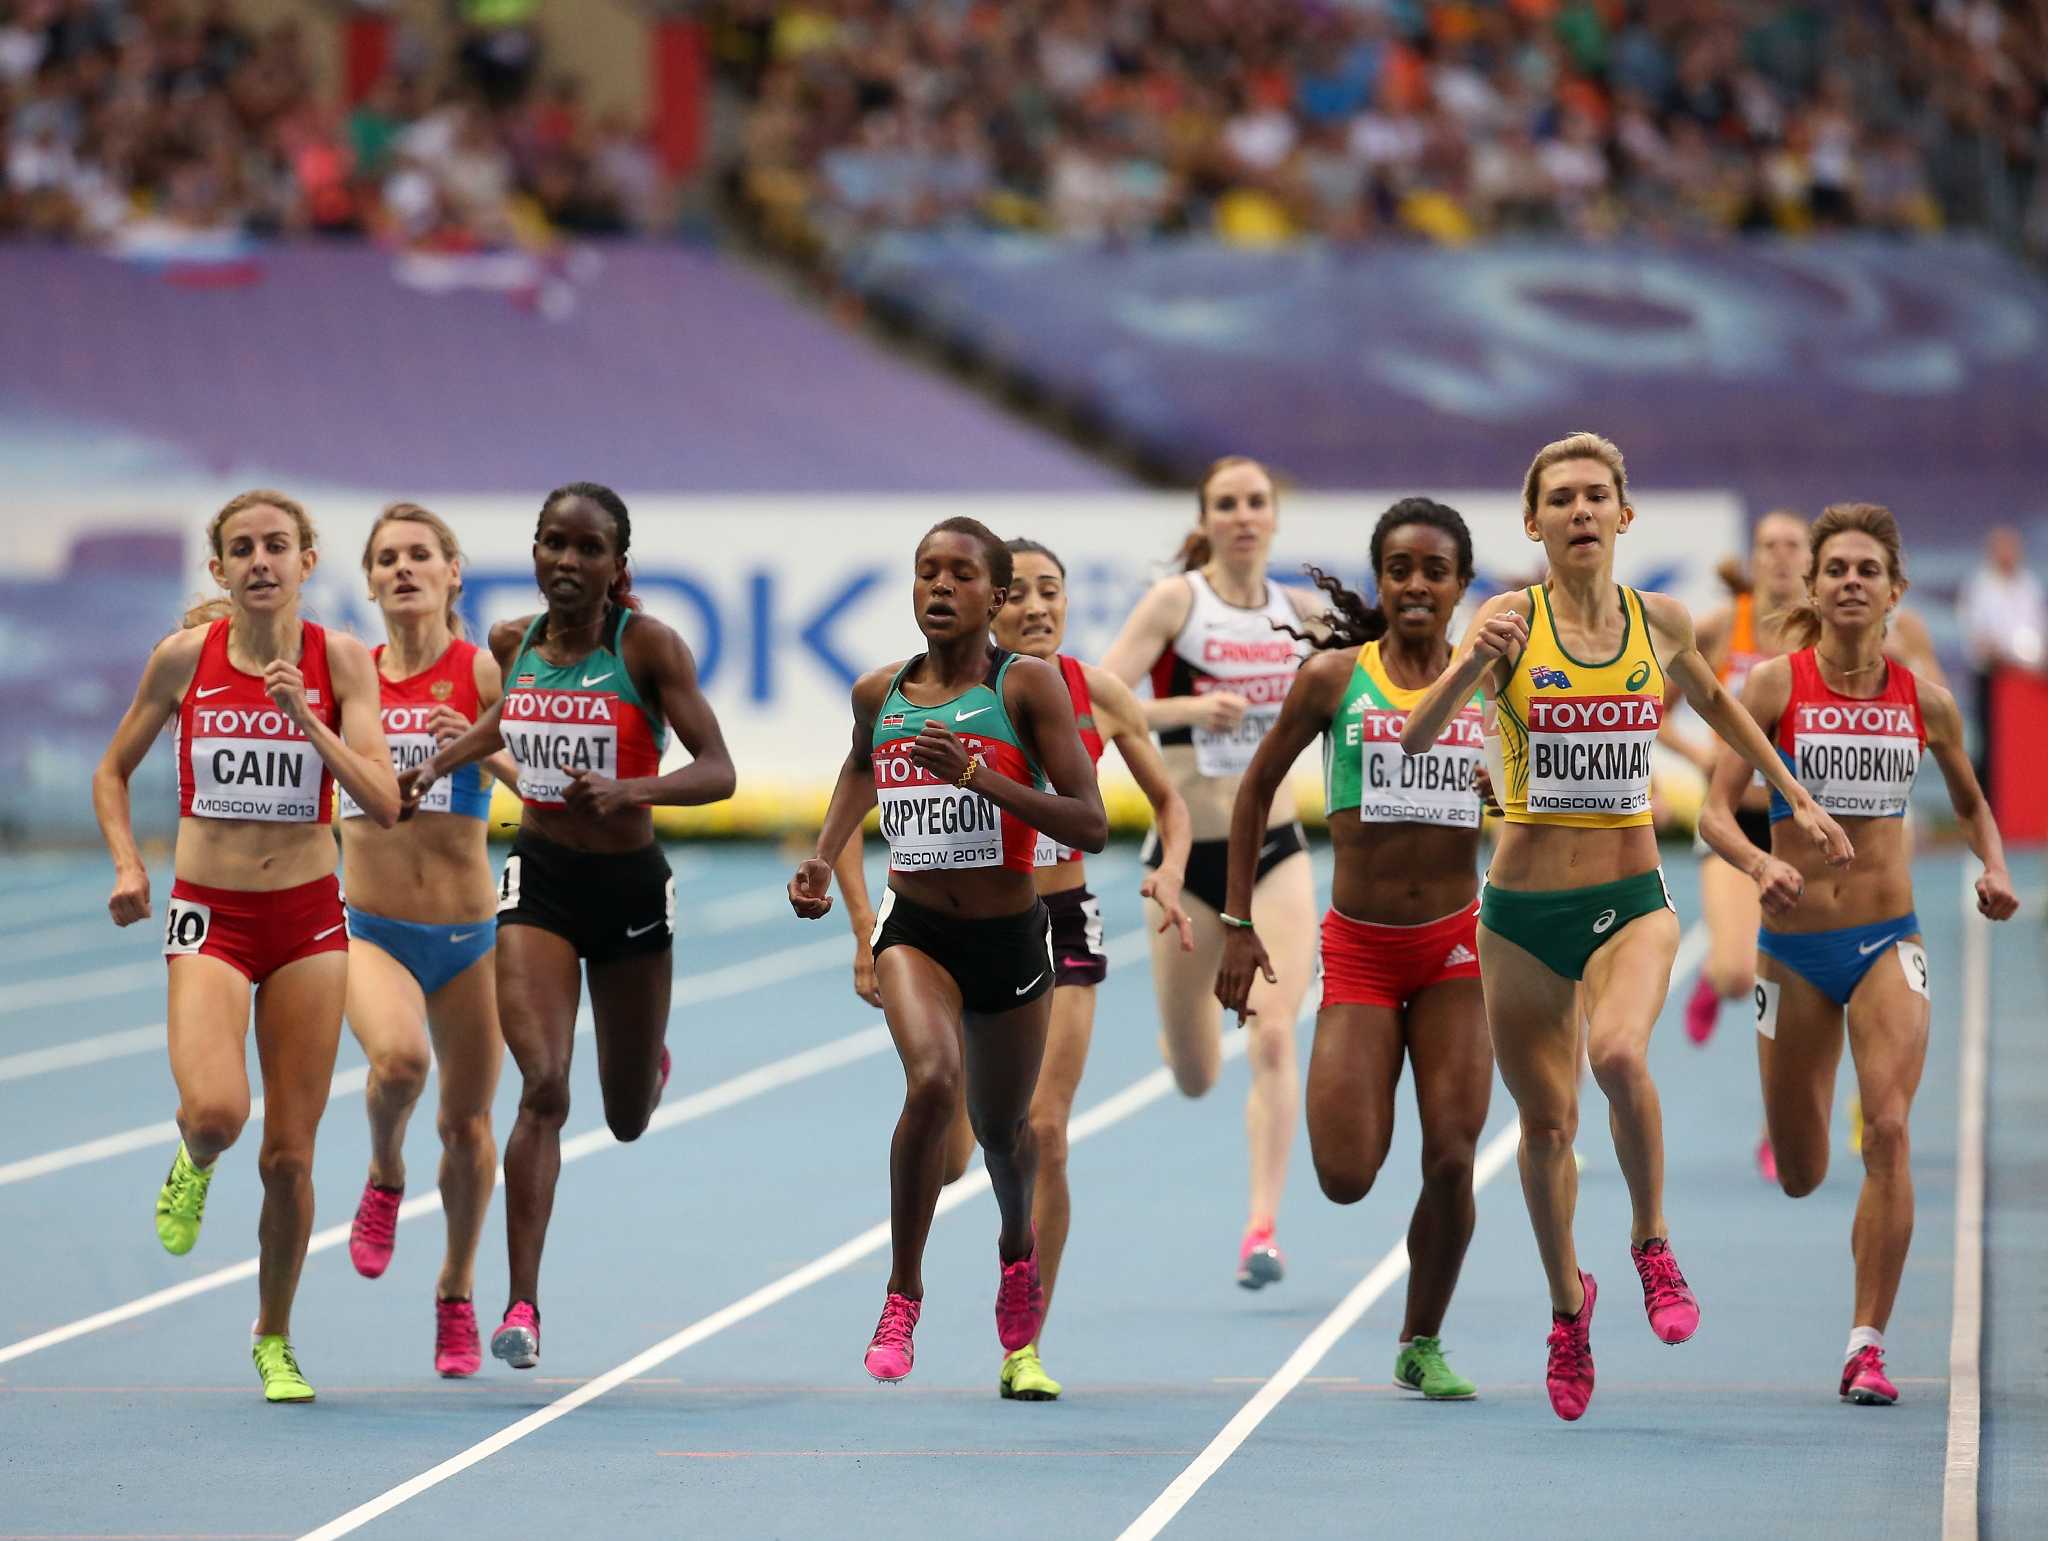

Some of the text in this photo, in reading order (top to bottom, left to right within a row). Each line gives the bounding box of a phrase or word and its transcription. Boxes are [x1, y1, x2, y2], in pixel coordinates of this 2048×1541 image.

[505, 693, 612, 720] TOYOTA
[1533, 701, 1658, 728] TOYOTA
[1800, 706, 1915, 733] TOYOTA
[198, 710, 305, 736] TOYOT
[506, 732, 610, 770] LANGAT
[212, 748, 303, 788] CAIN
[1369, 753, 1391, 788] G.
[1801, 745, 1915, 785] KOROBKINA
[197, 800, 315, 817] MOSCOW 2013
[1364, 804, 1444, 820] MOSCOW
[1530, 793, 1646, 809] MOSCOW 2013
[882, 794, 996, 837] KIPYEGON
[892, 847, 998, 866] MOSCOW 2013
[167, 908, 205, 946] 10
[1912, 953, 1928, 988] 9
